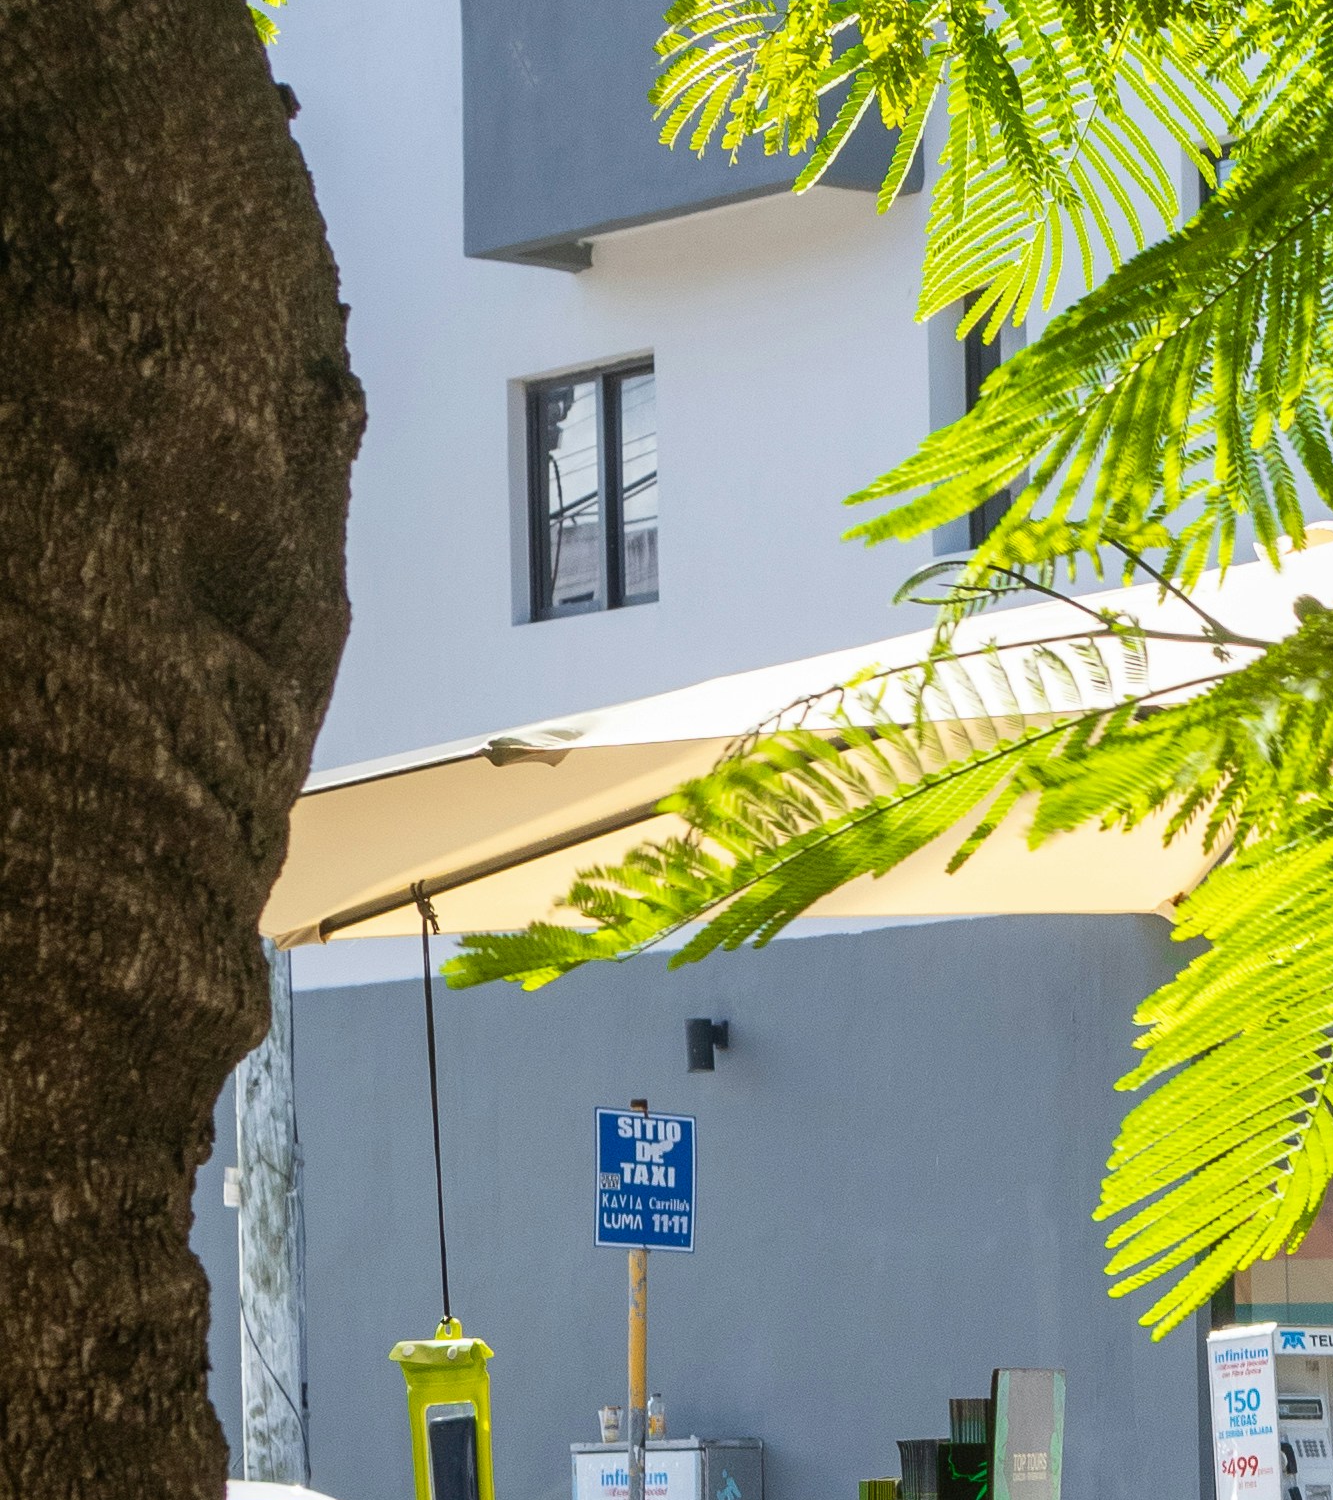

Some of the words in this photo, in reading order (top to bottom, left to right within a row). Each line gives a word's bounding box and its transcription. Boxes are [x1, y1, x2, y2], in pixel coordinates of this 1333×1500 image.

[617, 1116, 681, 1143] SITIO
[636, 1140, 664, 1164] DE
[620, 1162, 676, 1189] TAXI
[602, 1192, 643, 1211] KAVIA
[649, 1197, 690, 1213] Carrillo's
[603, 1212, 643, 1231] LUMA
[1214, 1347, 1269, 1364] infinitum
[1223, 1387, 1262, 1414] 150
[1229, 1413, 1258, 1429] MEGAS
[1013, 1453, 1026, 1472] TOP
[1221, 1455, 1259, 1478] $499
